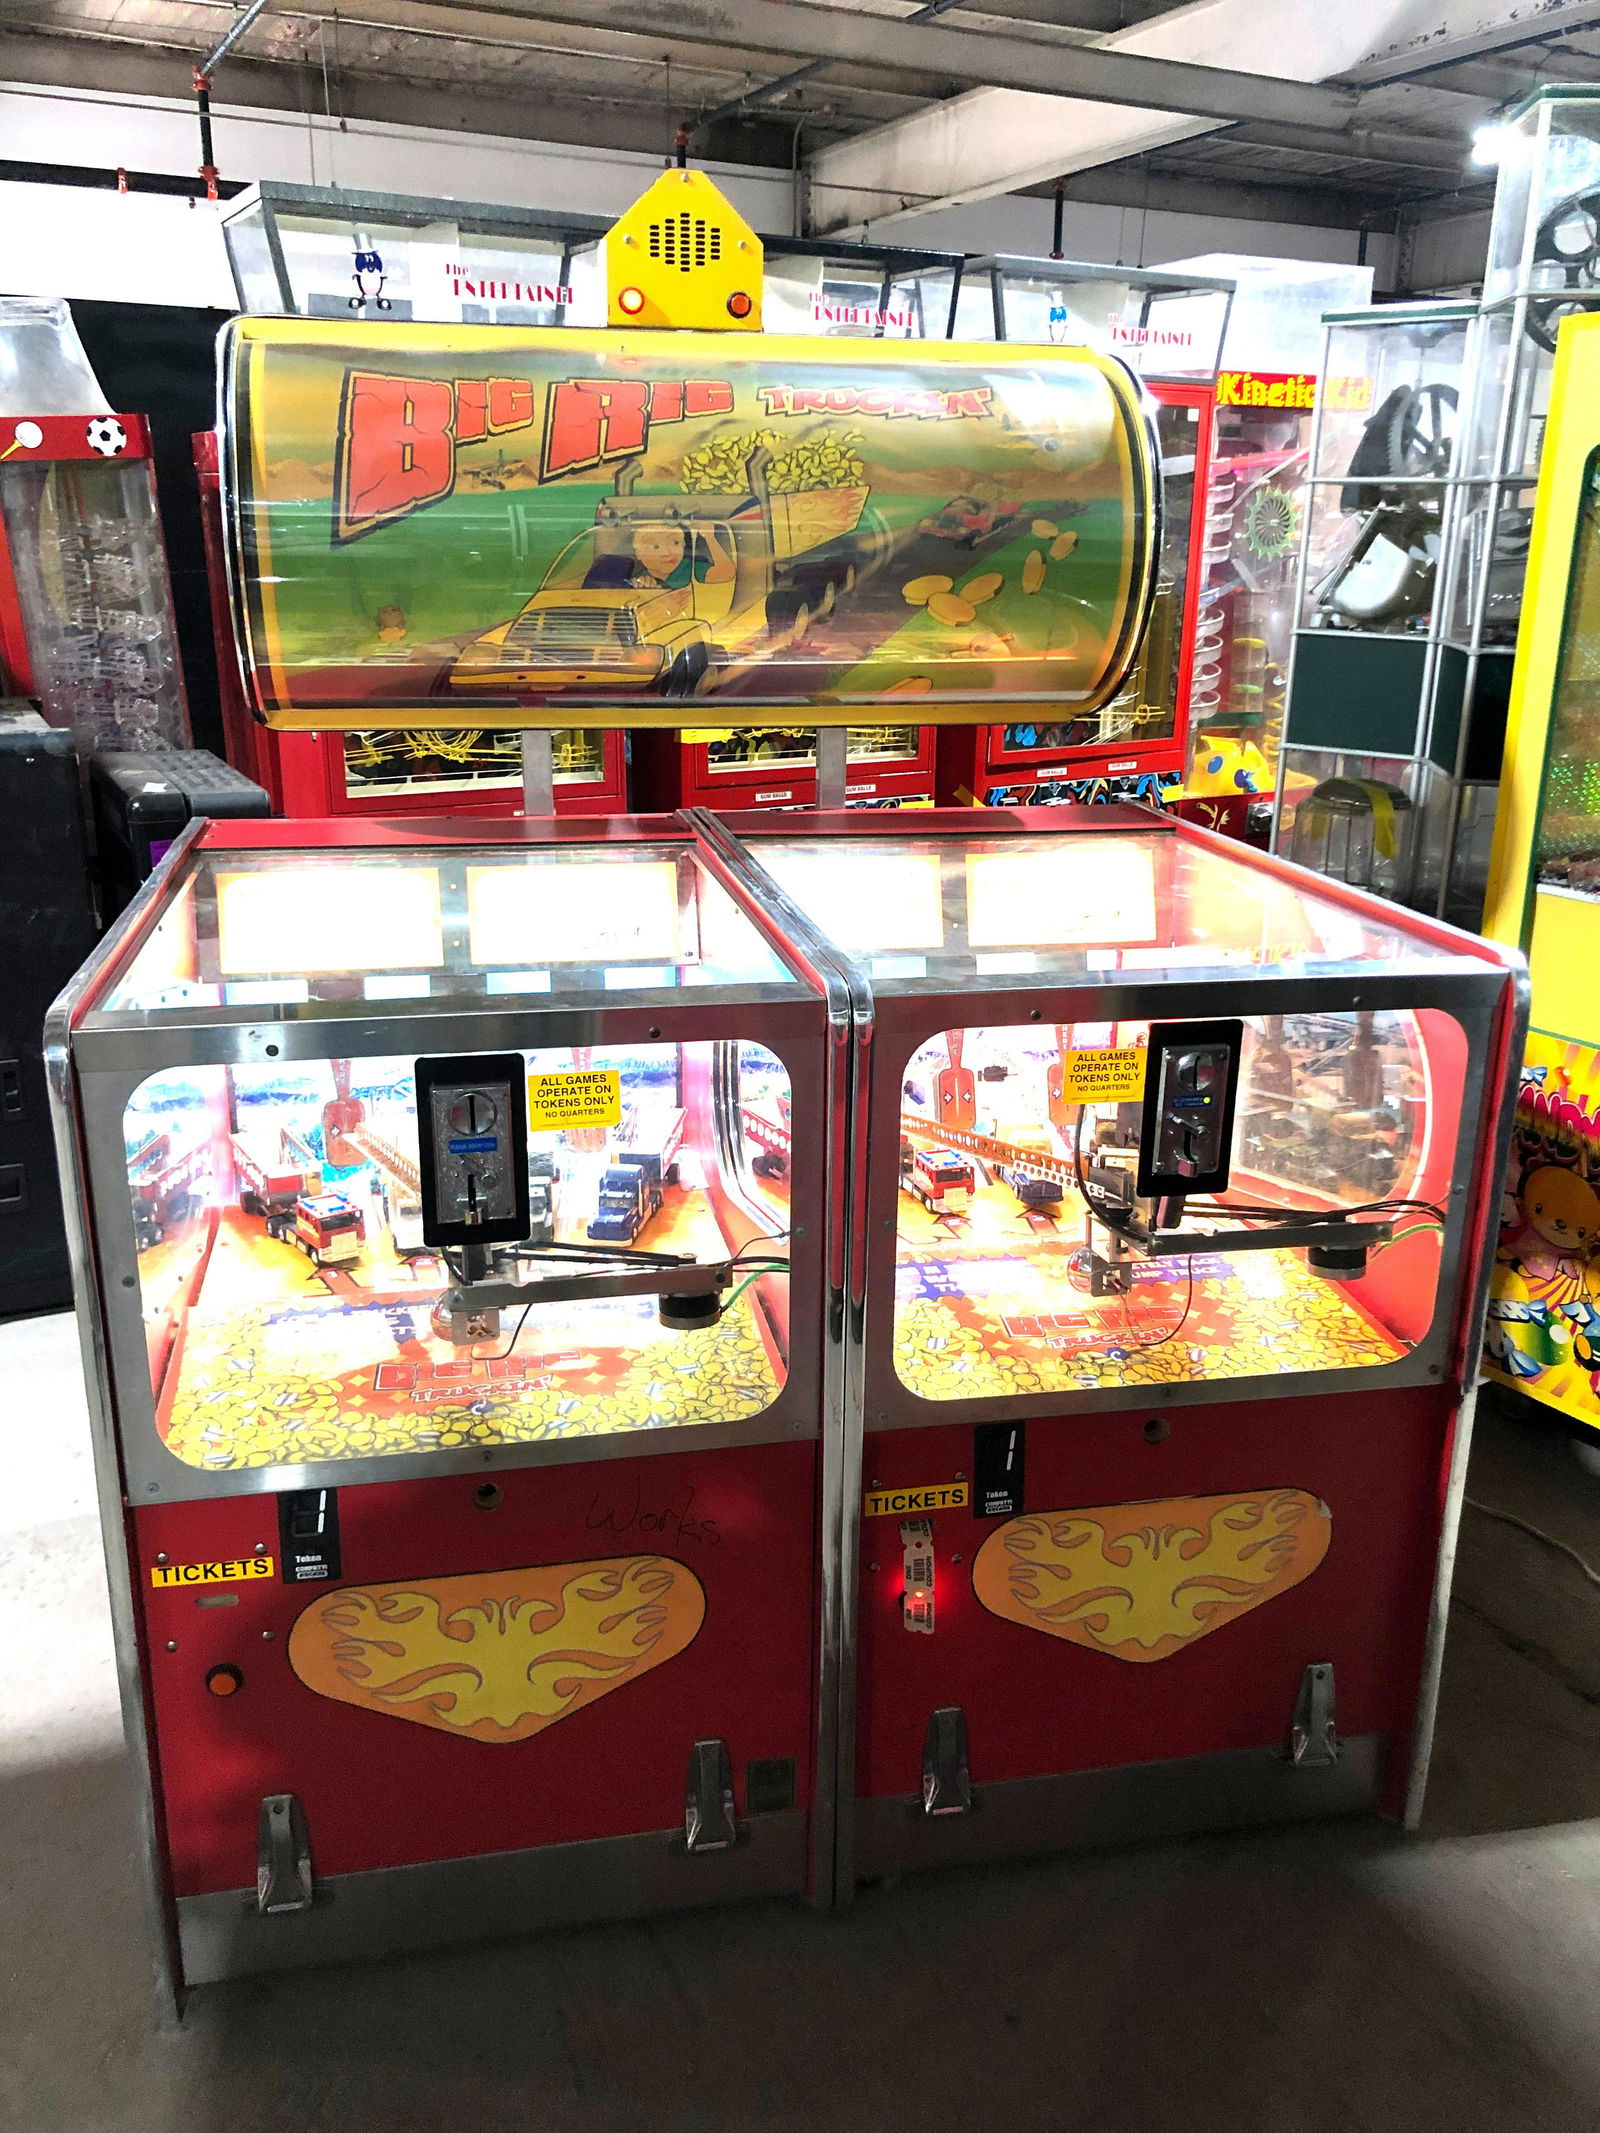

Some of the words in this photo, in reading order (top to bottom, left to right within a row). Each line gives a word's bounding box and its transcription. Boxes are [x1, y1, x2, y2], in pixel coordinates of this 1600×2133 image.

[1219, 372, 1316, 409] Kinetic
[1324, 376, 1374, 411] Kid
[330, 368, 534, 549] BIG
[538, 377, 735, 484] RIG
[1077, 1053, 1096, 1062] ALL
[1099, 1051, 1136, 1061] GAMES
[1072, 1063, 1121, 1073] OPERATE
[1123, 1062, 1139, 1071] ON
[540, 1076, 563, 1087] ALL
[565, 1073, 607, 1085] GAMES
[1069, 1074, 1110, 1083] TOKENS
[1112, 1072, 1141, 1082] ONLY
[537, 1086, 591, 1098] OPERATE
[594, 1085, 612, 1094] ON
[1090, 1083, 1131, 1091] QUARTERS
[533, 1099, 581, 1109] TOKENS
[584, 1095, 615, 1107] ONLY
[559, 1107, 605, 1117] QUARTERS
[1131, 1271, 1163, 1279] UMP
[870, 1489, 964, 1513] TICKETS
[158, 1559, 269, 1584] TICKETS
